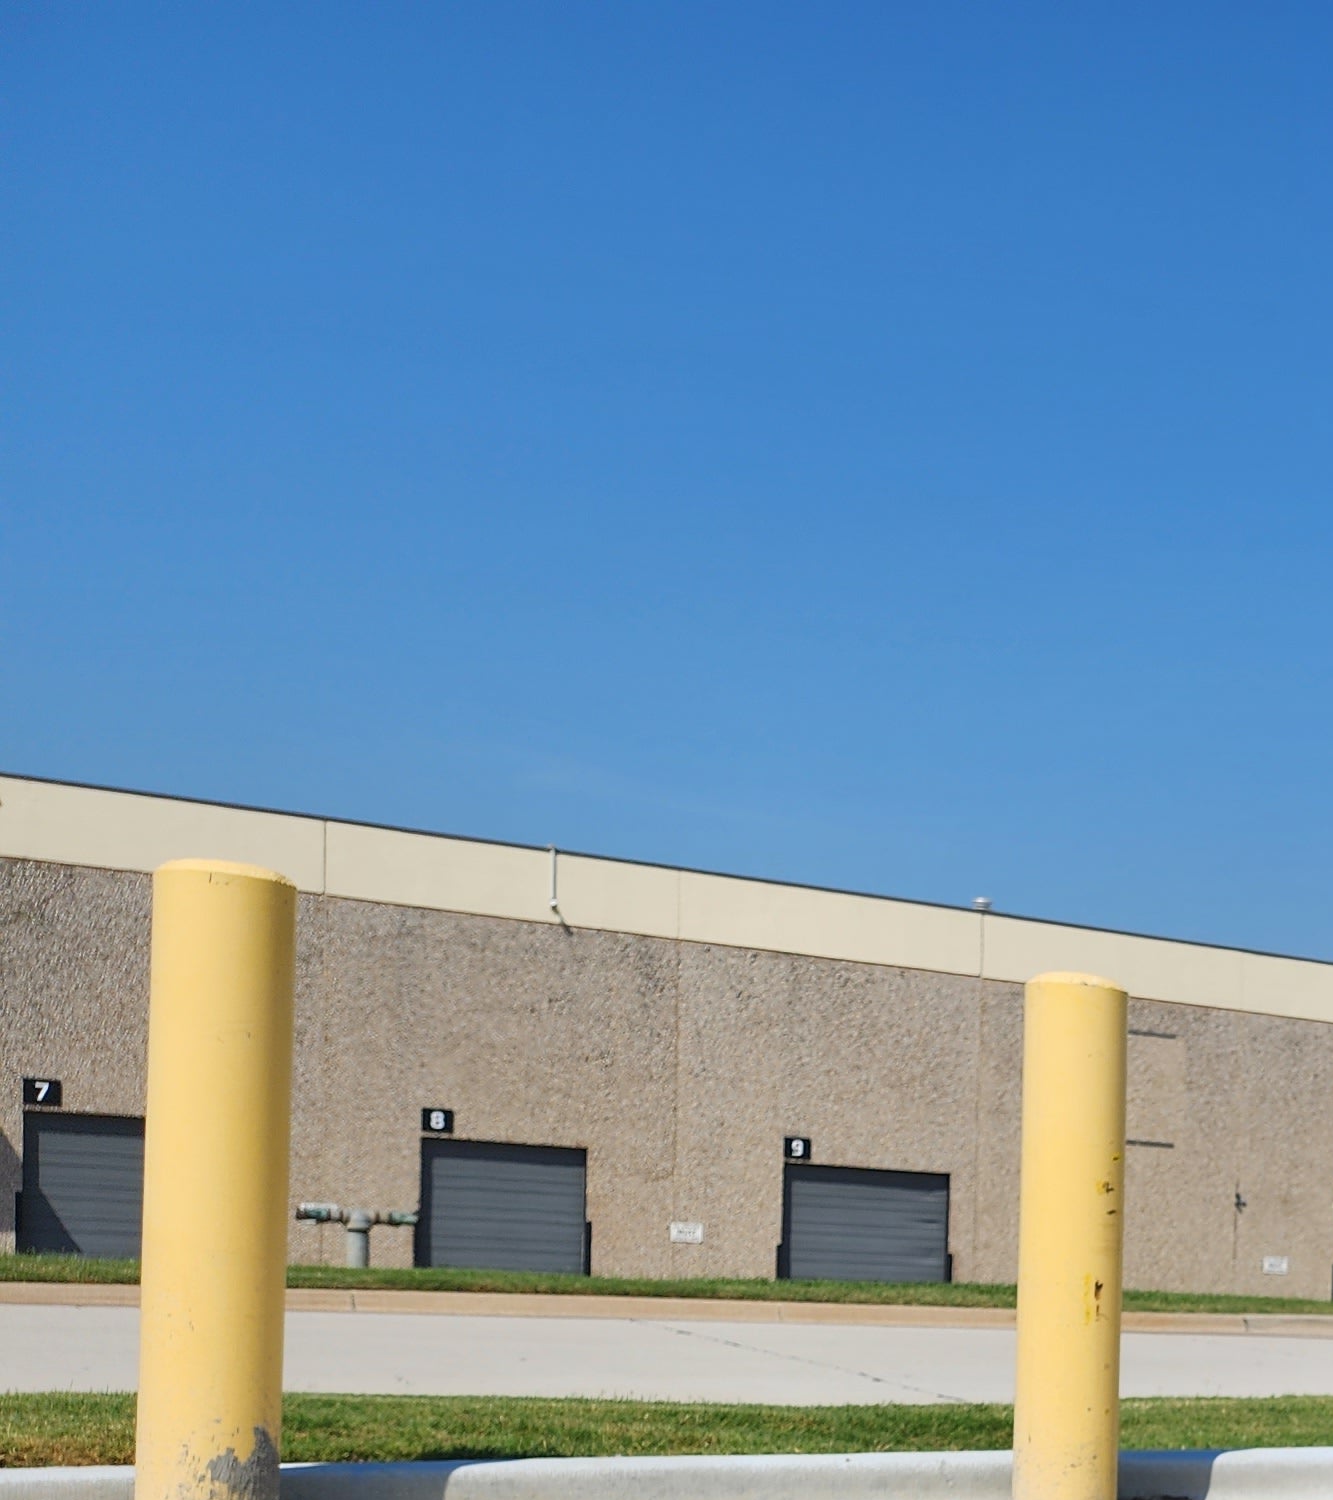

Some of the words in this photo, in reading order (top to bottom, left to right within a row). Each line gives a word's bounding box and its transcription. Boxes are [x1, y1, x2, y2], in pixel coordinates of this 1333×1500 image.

[34, 1081, 50, 1101] 7
[430, 1110, 445, 1130] 8
[791, 1139, 804, 1156] 9
